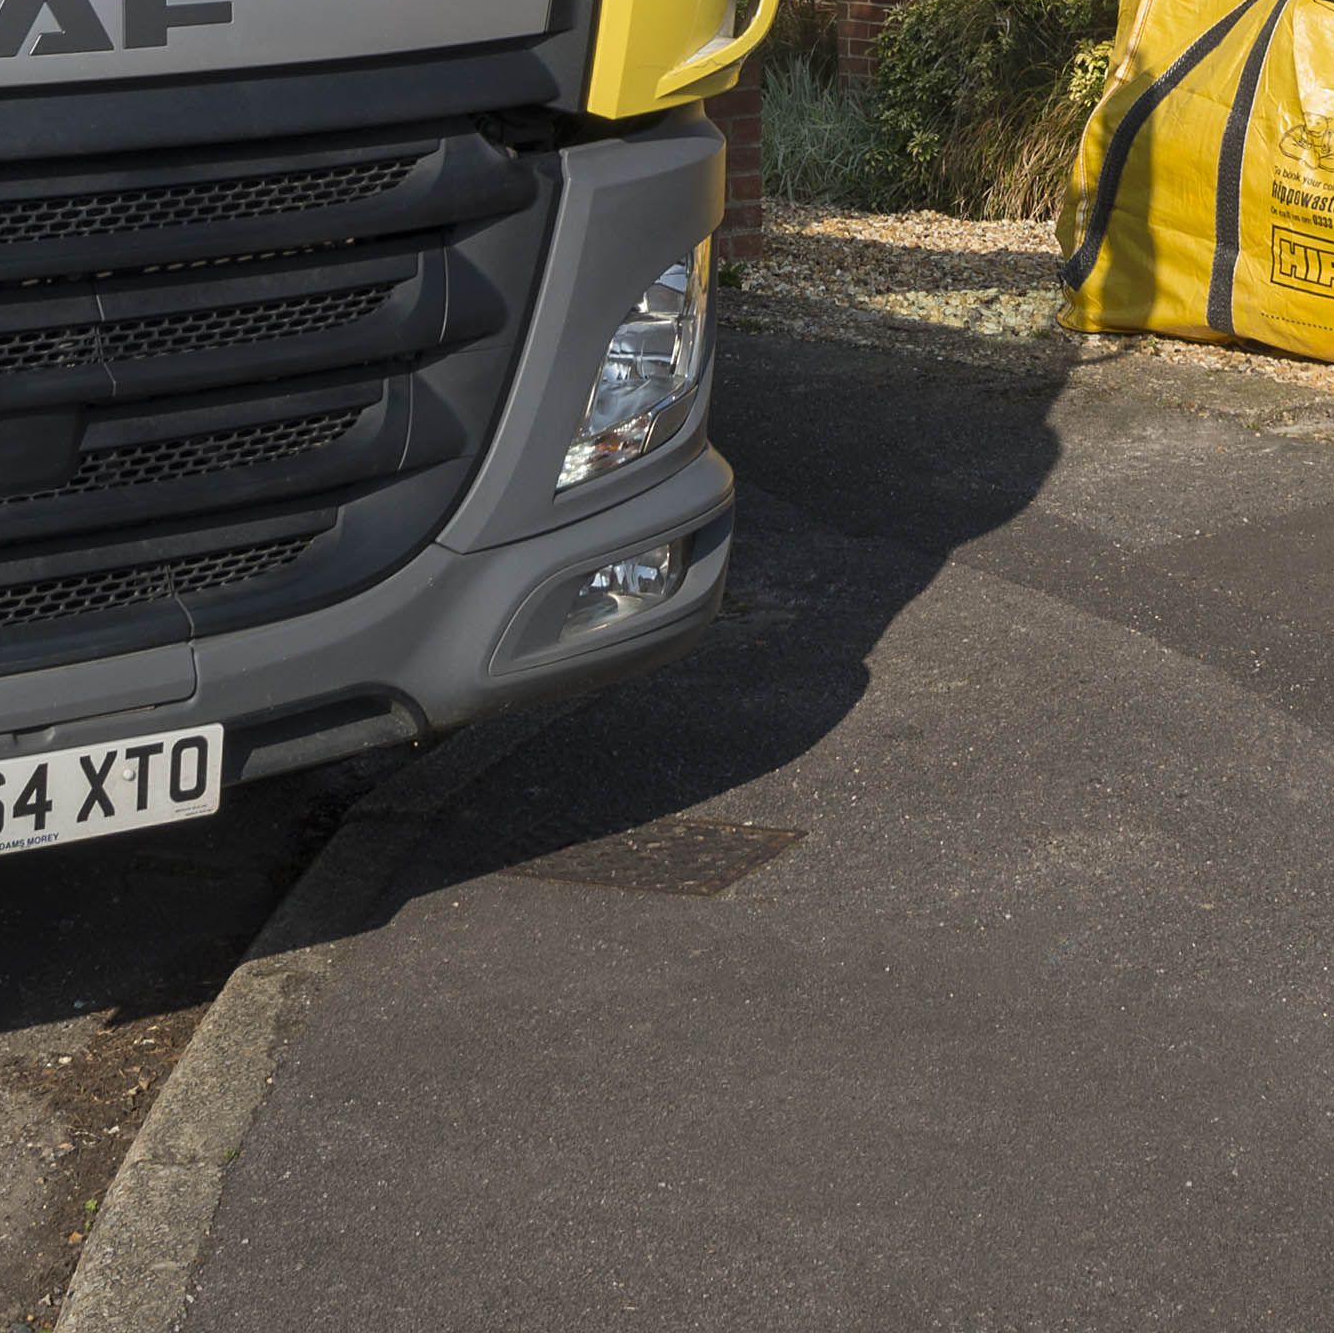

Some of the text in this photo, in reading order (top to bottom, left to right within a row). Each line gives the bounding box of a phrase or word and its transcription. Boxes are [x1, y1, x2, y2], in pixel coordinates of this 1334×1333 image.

[1282, 168, 1301, 182] book
[76, 734, 209, 824] XTO
[26, 833, 60, 847] MOREY
